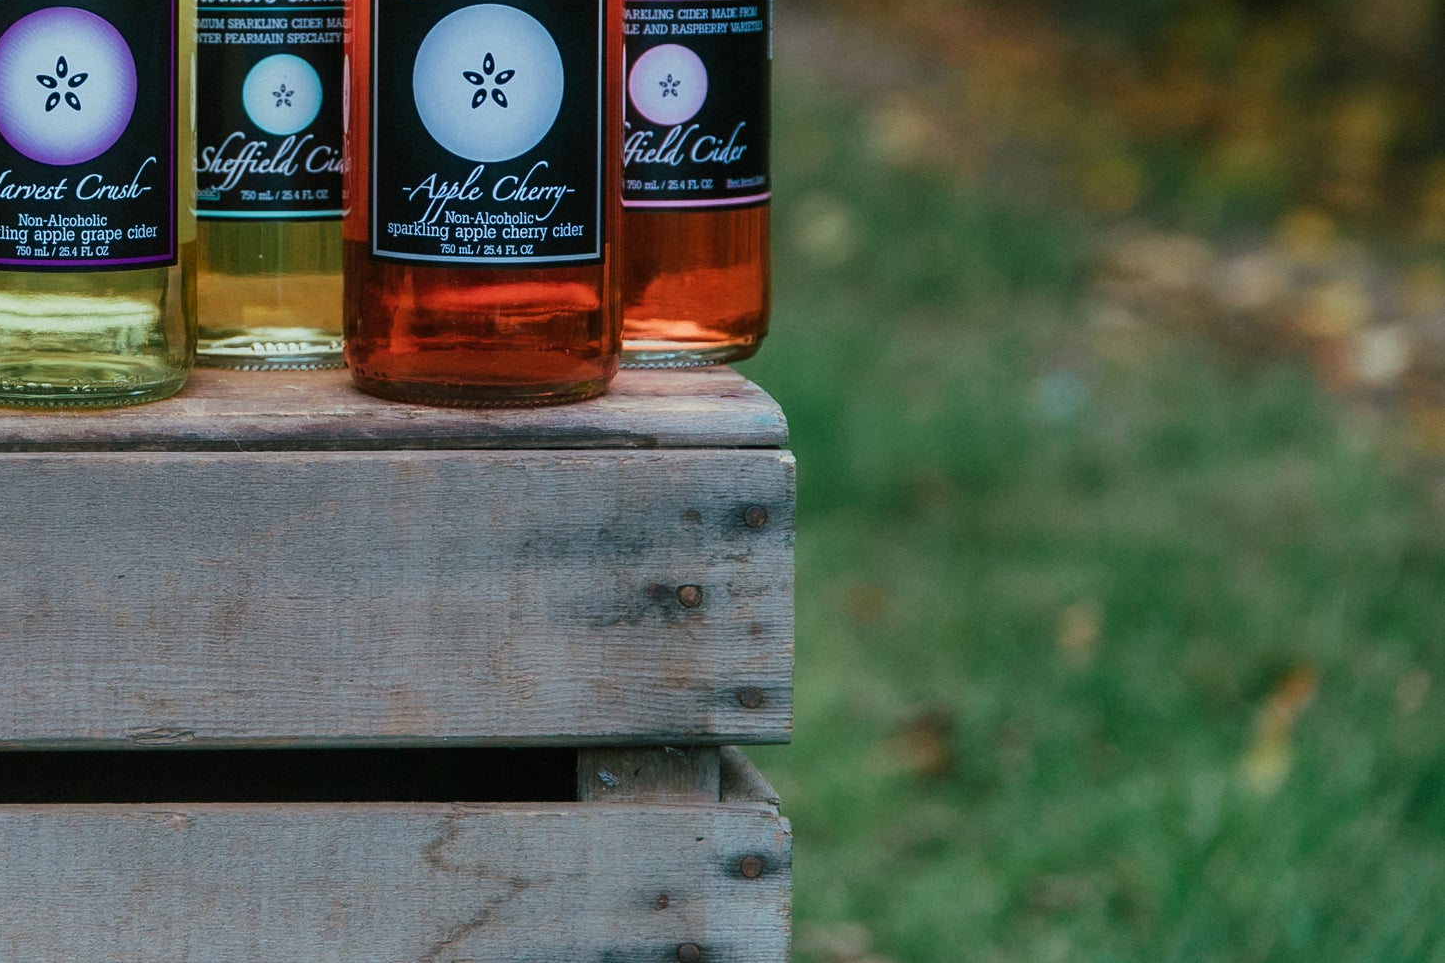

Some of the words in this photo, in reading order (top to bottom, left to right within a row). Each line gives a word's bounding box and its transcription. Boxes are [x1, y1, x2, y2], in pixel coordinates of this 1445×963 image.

[677, 8, 708, 20] CIDER
[711, 8, 737, 18] MADE
[227, 18, 288, 30] SPARKLING
[291, 18, 323, 29] CIDER
[643, 23, 669, 34] AND
[671, 22, 729, 34] RASPBERRY
[225, 33, 283, 44] PEARMAIN
[691, 121, 747, 164] Cider
[196, 131, 314, 192] Sheffield
[627, 179, 642, 190] 750
[645, 179, 659, 190] mL
[667, 179, 685, 190] 25.4
[688, 179, 699, 190] FL
[701, 179, 713, 190] OZ
[241, 190, 255, 200] 750
[259, 190, 273, 200] mL
[282, 190, 299, 200] 25.4
[303, 190, 313, 200] FL
[315, 190, 329, 200] OZ
[18, 214, 107, 226] Non-Alcoholic
[445, 210, 535, 224] Non-Alcoholic
[34, 226, 75, 244] apple
[81, 227, 122, 244] grape
[127, 225, 158, 240] cider
[387, 221, 449, 241] sparkling
[455, 224, 497, 242] apple
[501, 224, 547, 242] cherry
[552, 224, 584, 238] cider
[16, 246, 31, 256] 750
[34, 246, 49, 256] mL
[59, 246, 77, 256] 25.4
[81, 246, 93, 256] FL
[95, 246, 109, 256] OZ
[440, 244, 455, 255] 750
[459, 244, 473, 255] mL
[483, 244, 503, 255] 25.4
[505, 244, 518, 255] FL
[520, 244, 534, 255] OZ
